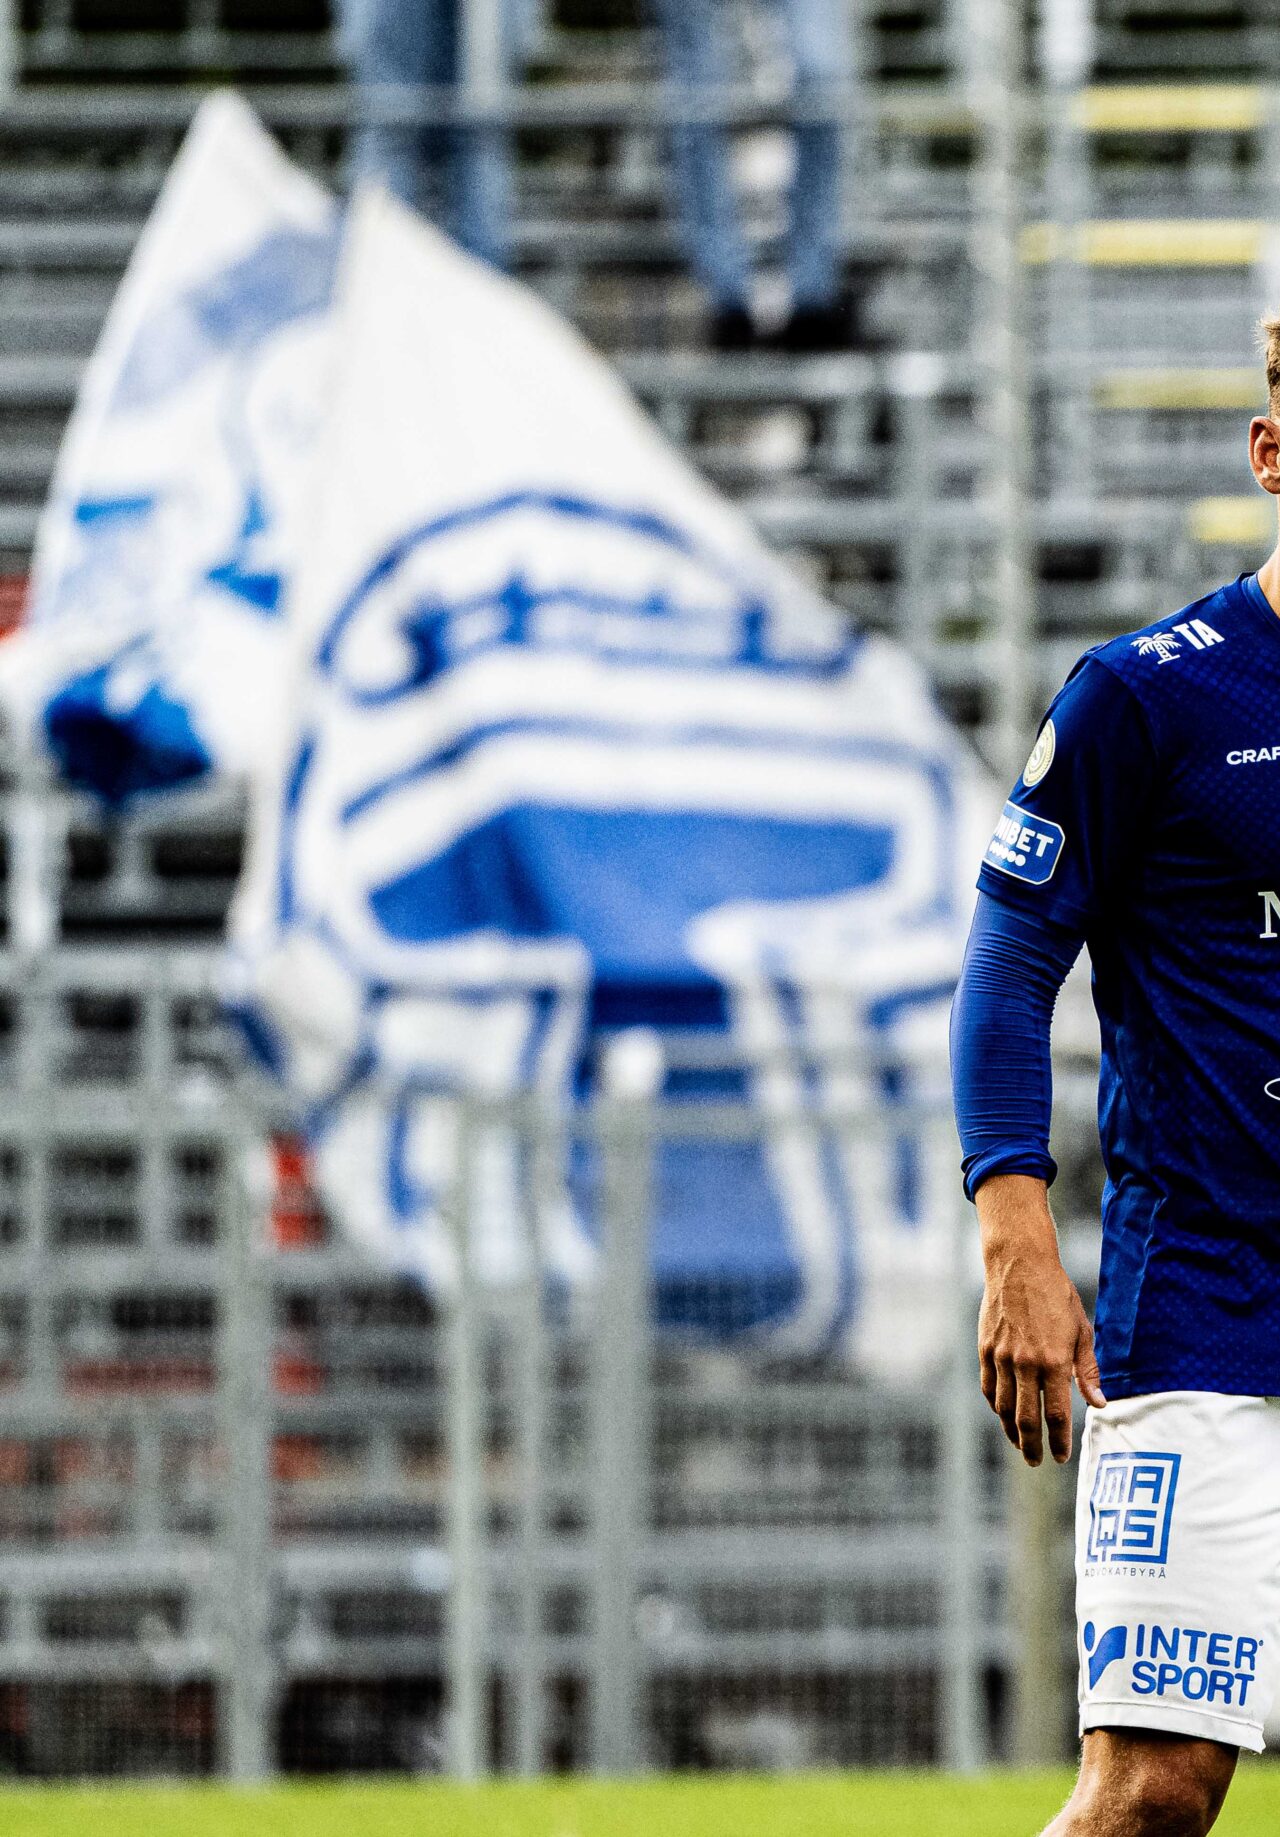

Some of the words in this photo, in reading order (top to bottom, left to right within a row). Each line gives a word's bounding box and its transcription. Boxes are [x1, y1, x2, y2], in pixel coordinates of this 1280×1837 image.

[1172, 619, 1225, 650] TA
[1084, 1567, 1166, 1579] ADVOKATBYRÅ
[1135, 1623, 1257, 1671] INTER
[1131, 1660, 1255, 1706] SPORT
